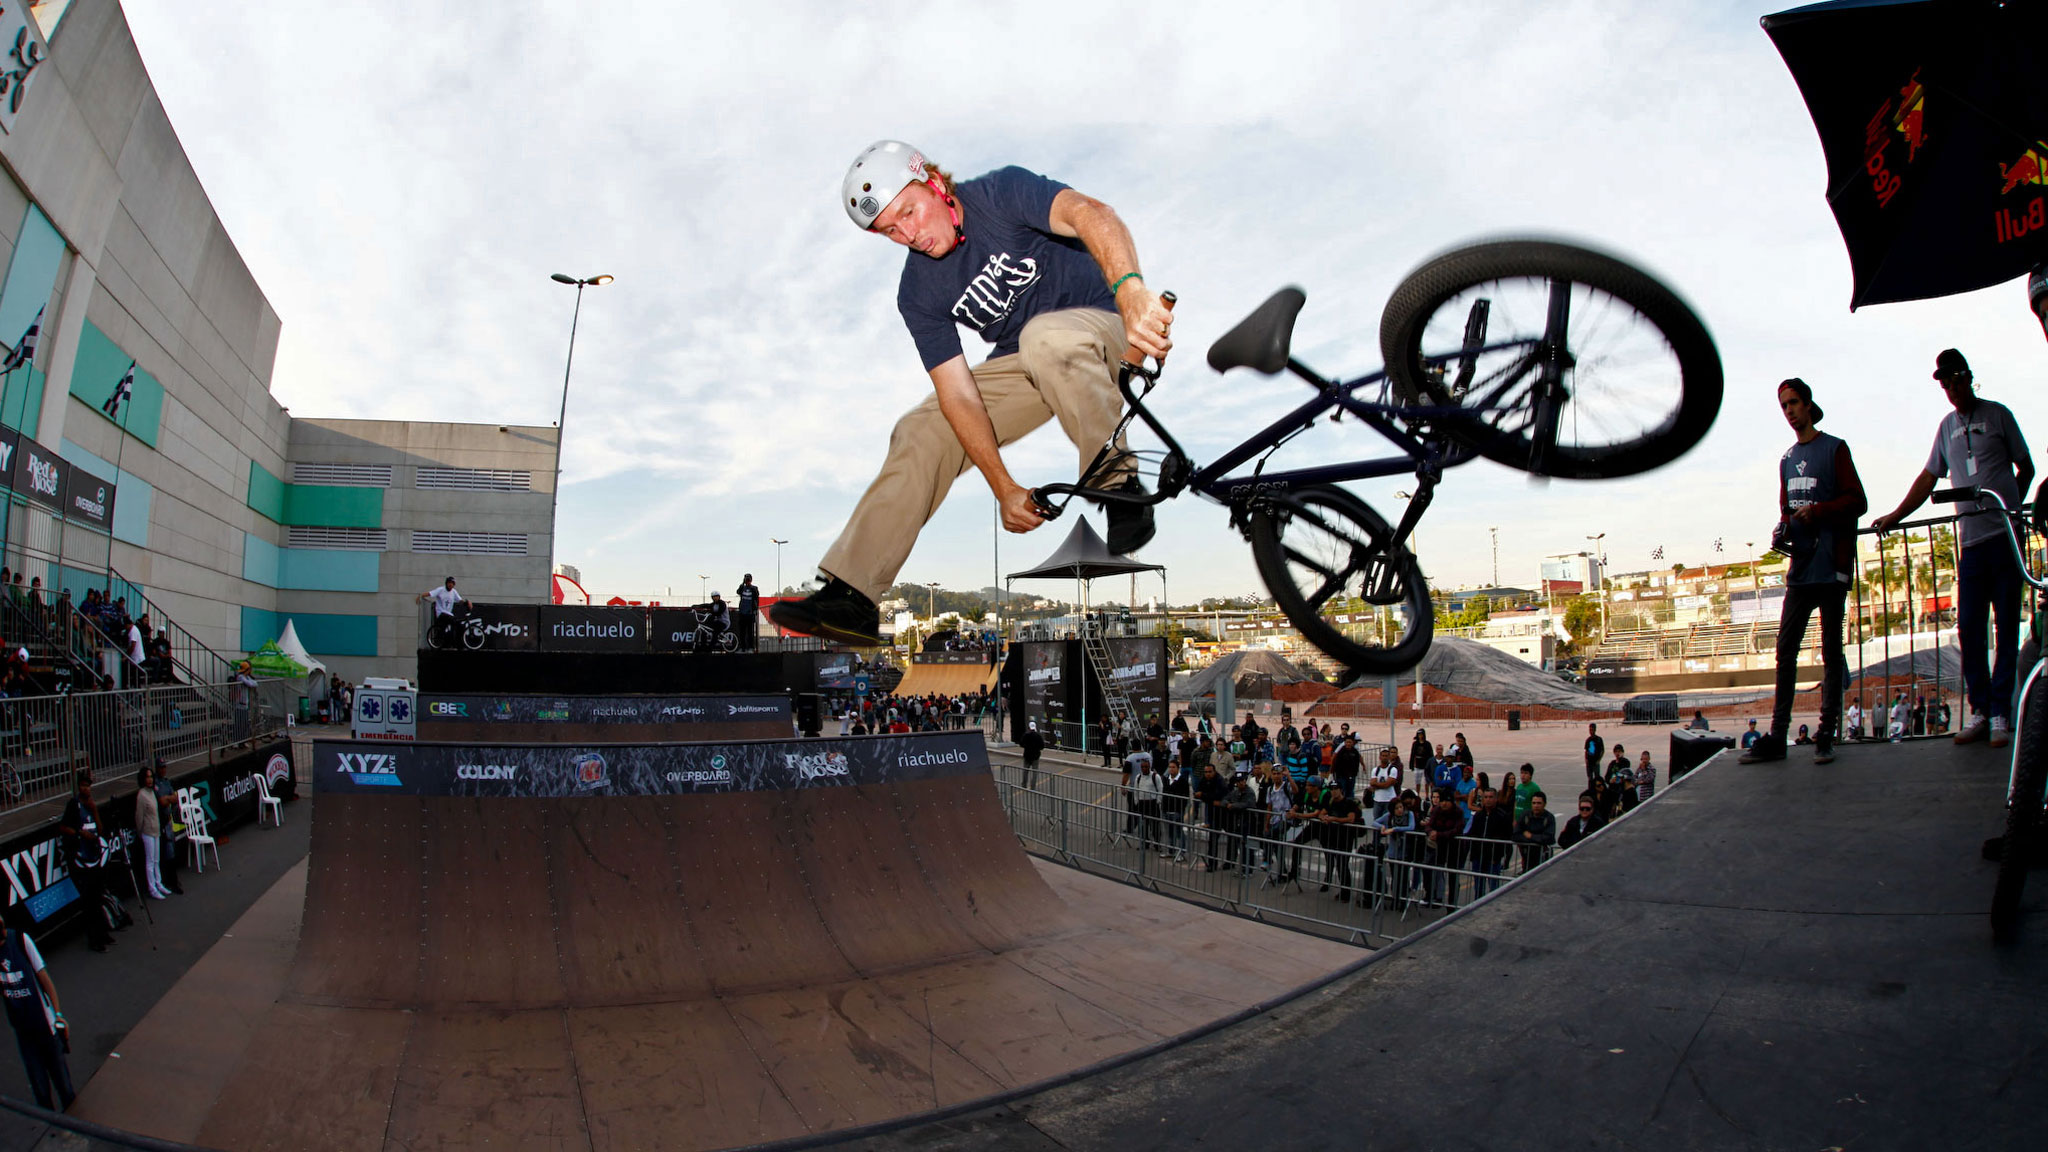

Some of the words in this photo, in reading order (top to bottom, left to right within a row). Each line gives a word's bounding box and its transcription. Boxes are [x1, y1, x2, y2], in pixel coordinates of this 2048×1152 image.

[26, 452, 51, 478] Red
[30, 470, 57, 496] Nose
[75, 495, 105, 517] OVERBOARD
[553, 620, 635, 638] riachuelo
[430, 702, 471, 718] CBER
[592, 706, 638, 717] riachuelo
[336, 752, 390, 774] XYZ
[388, 754, 396, 774] LIVE
[785, 752, 828, 769] Red
[897, 748, 968, 768] riachuelo
[456, 764, 517, 780] COLONY
[666, 769, 731, 782] OVERBOARD
[800, 762, 850, 781] Nose
[0, 837, 56, 908] XYZ
